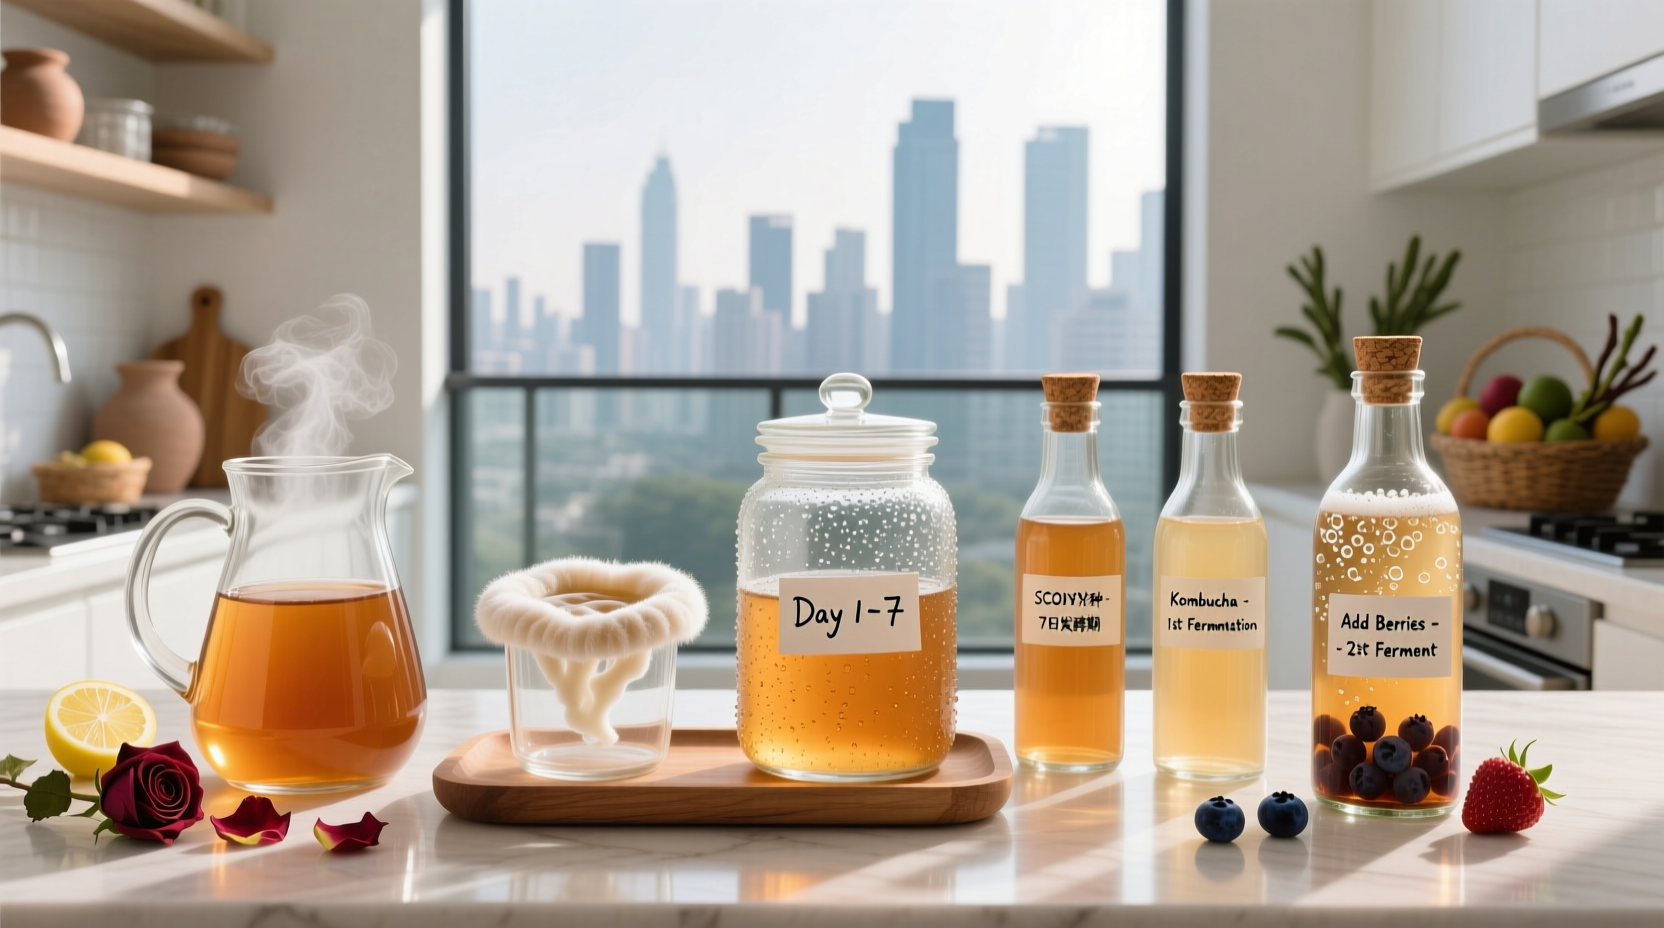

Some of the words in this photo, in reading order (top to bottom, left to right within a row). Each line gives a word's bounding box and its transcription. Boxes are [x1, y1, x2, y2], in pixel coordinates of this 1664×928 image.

[1170, 591, 1238, 608] Kombucha
[793, 596, 843, 638] Day
[855, 595, 904, 627] 1-7
[1341, 612, 1369, 630] Add
[1376, 614, 1425, 631] Berries
[1375, 641, 1438, 658] Ferment
